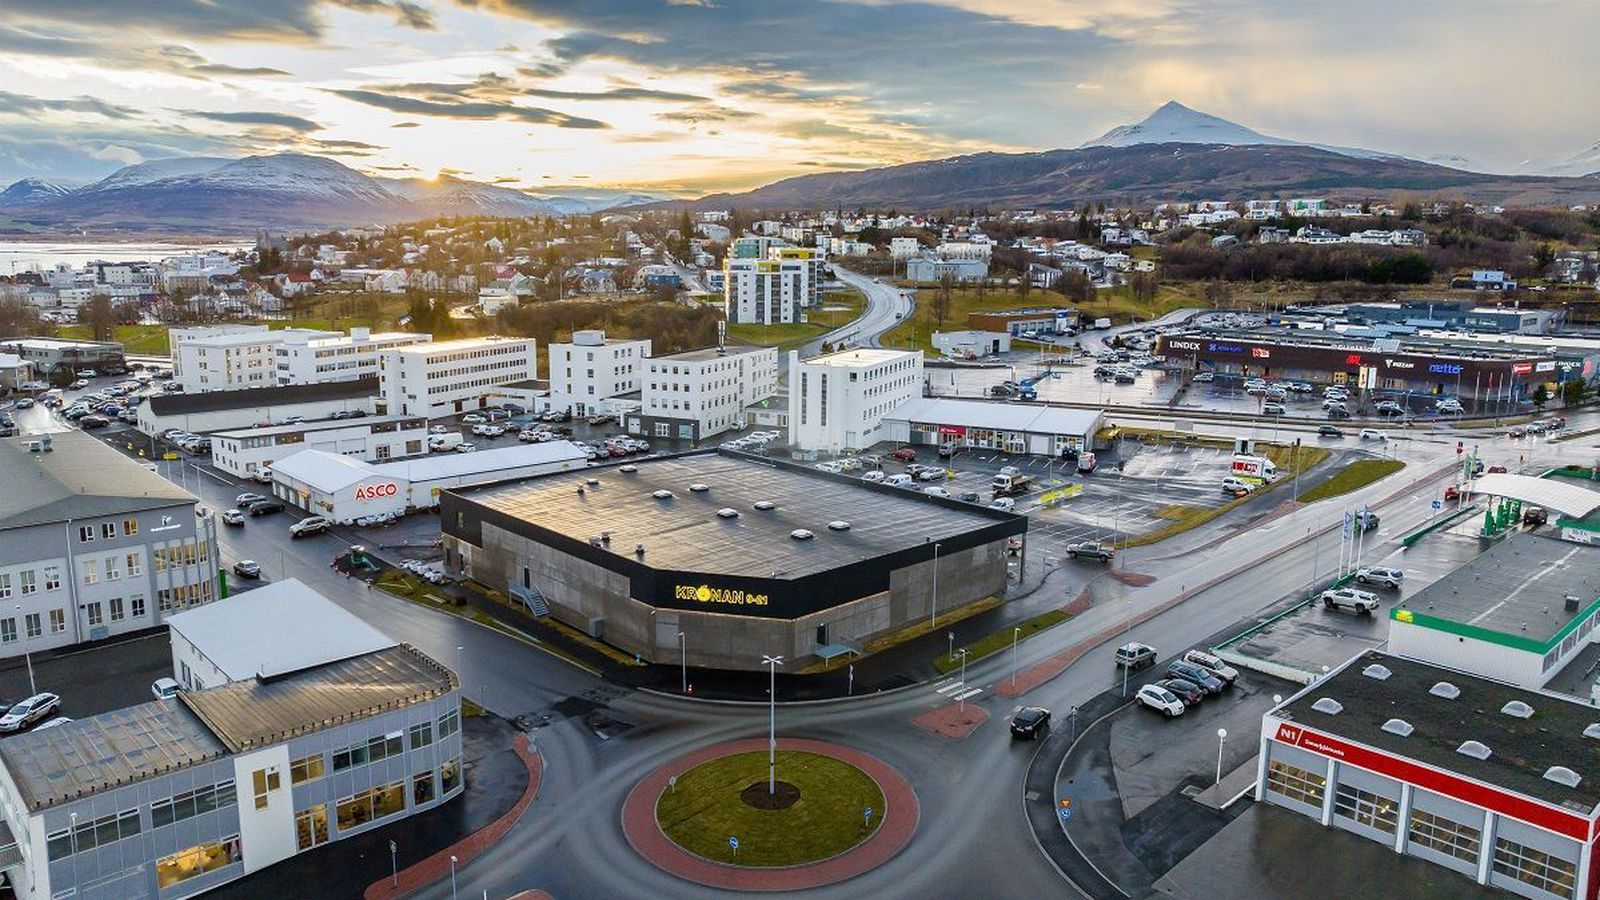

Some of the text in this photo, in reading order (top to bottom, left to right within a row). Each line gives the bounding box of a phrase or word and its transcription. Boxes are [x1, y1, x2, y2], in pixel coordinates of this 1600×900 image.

[1169, 341, 1200, 350] LINDEX
[355, 484, 397, 501] ASCO
[746, 594, 768, 605] 9-21
[1280, 728, 1296, 741] N1
